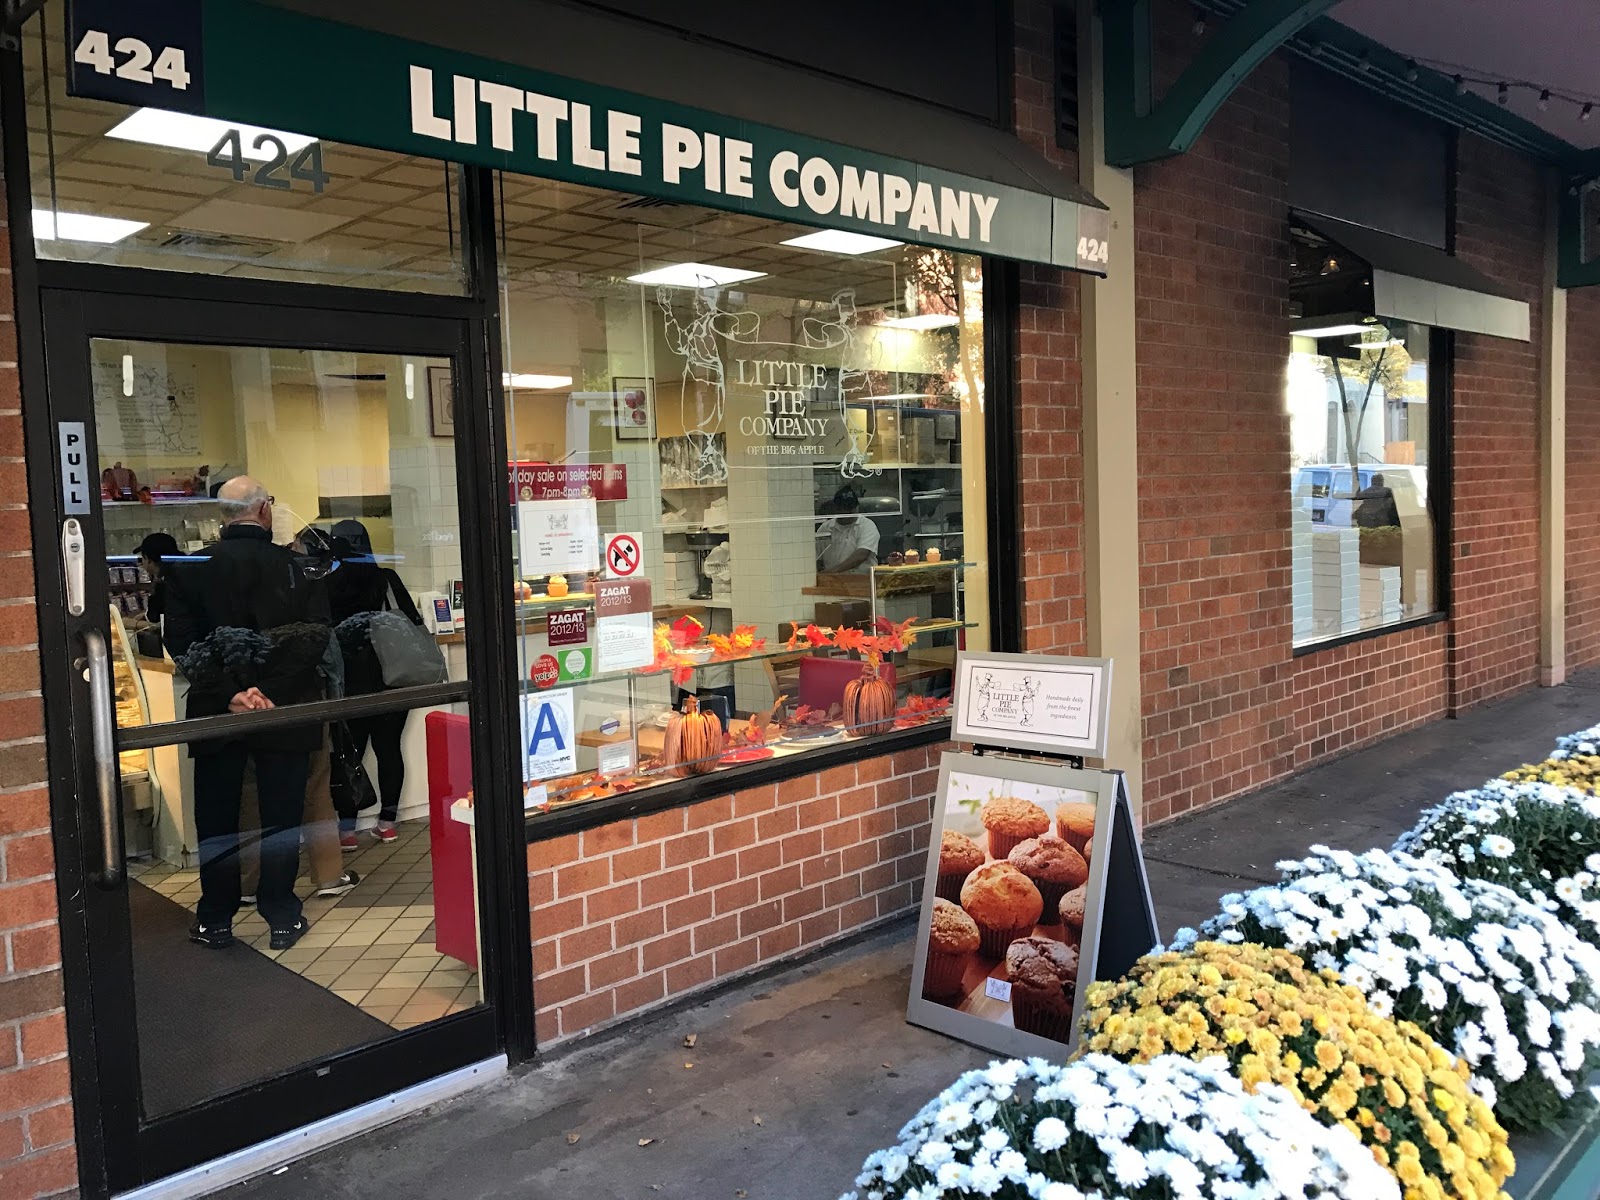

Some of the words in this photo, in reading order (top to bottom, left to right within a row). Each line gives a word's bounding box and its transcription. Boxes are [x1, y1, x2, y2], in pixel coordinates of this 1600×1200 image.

[75, 30, 190, 91] 424
[207, 128, 330, 193] 424
[409, 64, 642, 176] LITTLE
[662, 122, 753, 198] PIE
[769, 150, 999, 243] COMPANY
[1077, 236, 1108, 264] 424
[736, 358, 828, 390] LITTLE
[762, 388, 806, 417] PIE
[740, 416, 829, 436] COMPANY
[747, 445, 758, 455] OF
[759, 445, 779, 455] THE
[781, 445, 796, 455] BIG
[798, 445, 825, 455] APPLE
[66, 434, 82, 504] PULL
[517, 469, 534, 485] day
[537, 468, 554, 482] sale
[557, 471, 567, 481] on
[569, 468, 602, 481] selected
[541, 486, 580, 499] 7pm-8pm
[600, 586, 630, 597] ZAGAT
[601, 595, 632, 607] 2012/13
[550, 612, 584, 625] ZAGAT
[550, 622, 585, 636] 2012/13
[534, 670, 551, 682] yelp
[993, 692, 1019, 701] LITTLE
[1000, 700, 1011, 708] PIE
[529, 702, 566, 756] A
